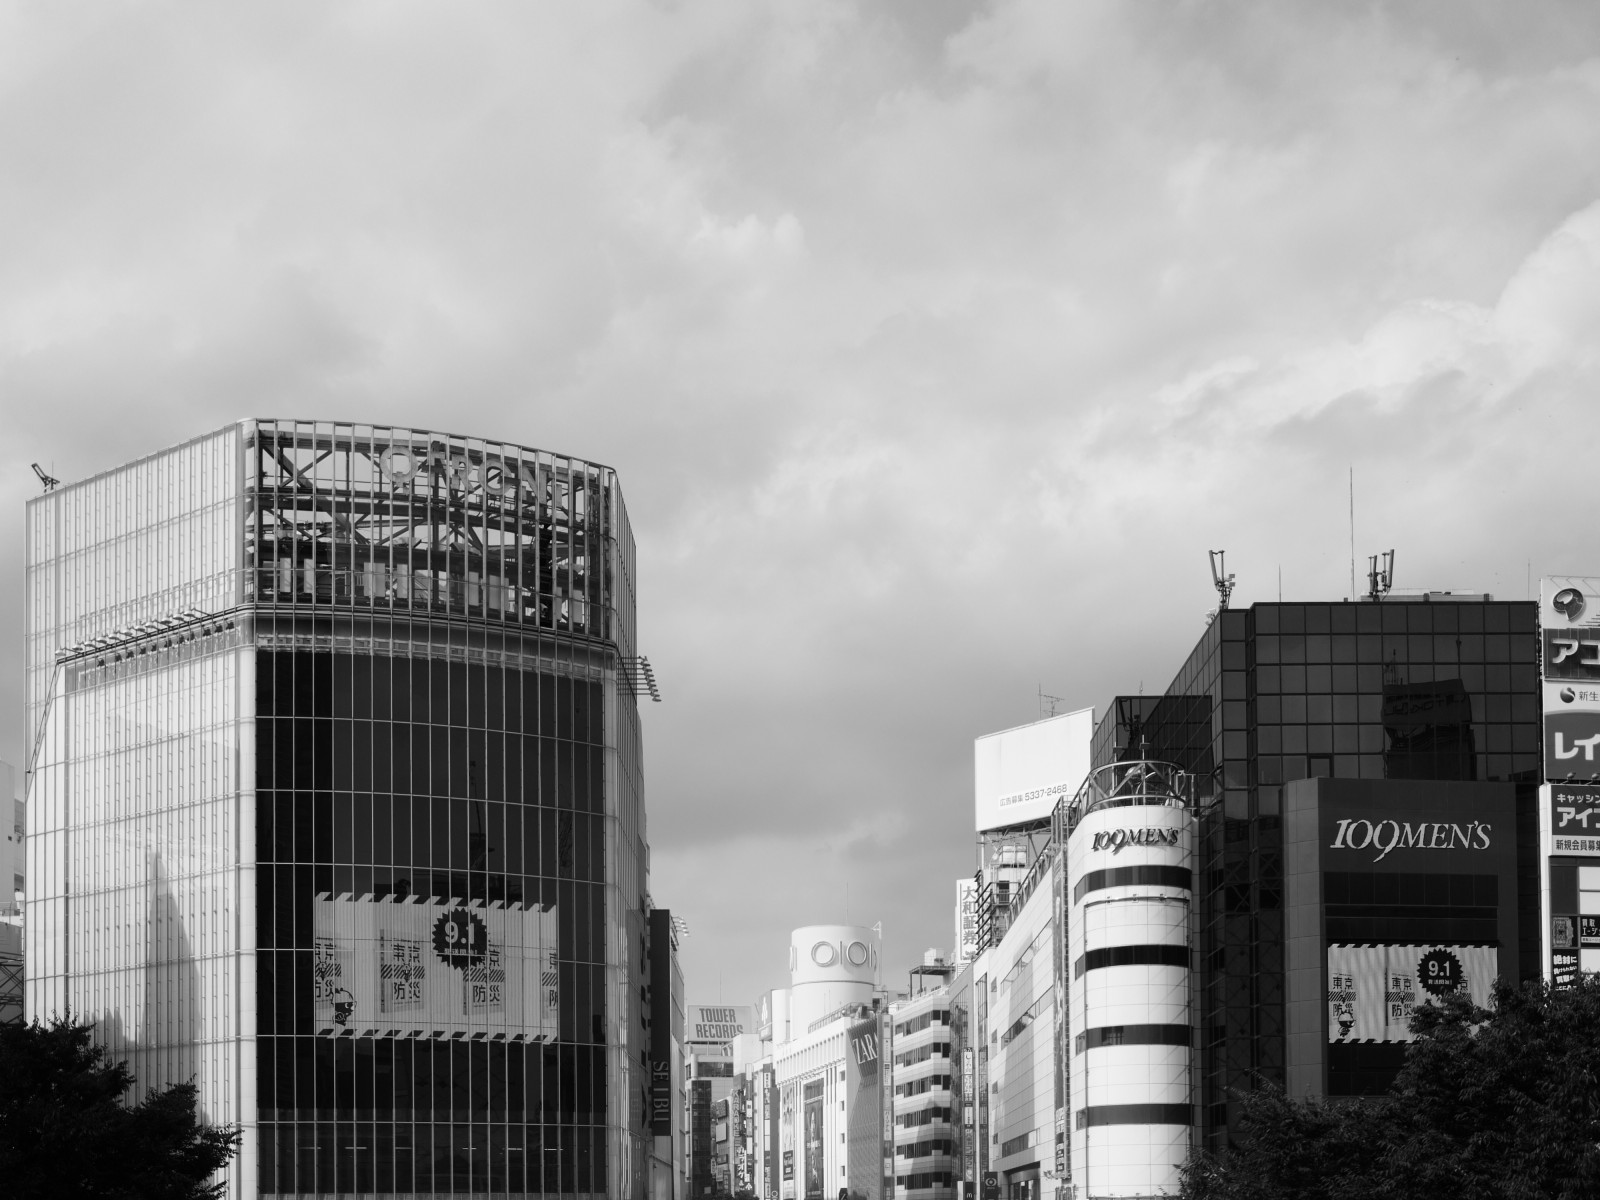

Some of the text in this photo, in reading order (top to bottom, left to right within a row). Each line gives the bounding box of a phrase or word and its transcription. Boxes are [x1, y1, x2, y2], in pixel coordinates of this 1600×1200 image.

[1579, 690, 1600, 702] 新生
[1024, 784, 1068, 802] 5337-2468
[444, 921, 475, 945] 9.1
[393, 943, 420, 963] 東京
[1428, 960, 1450, 977] 9.1
[393, 981, 420, 1000] 防災
[1332, 977, 1353, 990] 東京
[1391, 977, 1412, 991] 東京
[473, 985, 501, 1003] 防災
[699, 1007, 736, 1024] TOWER
[696, 1023, 744, 1039] RECORDS
